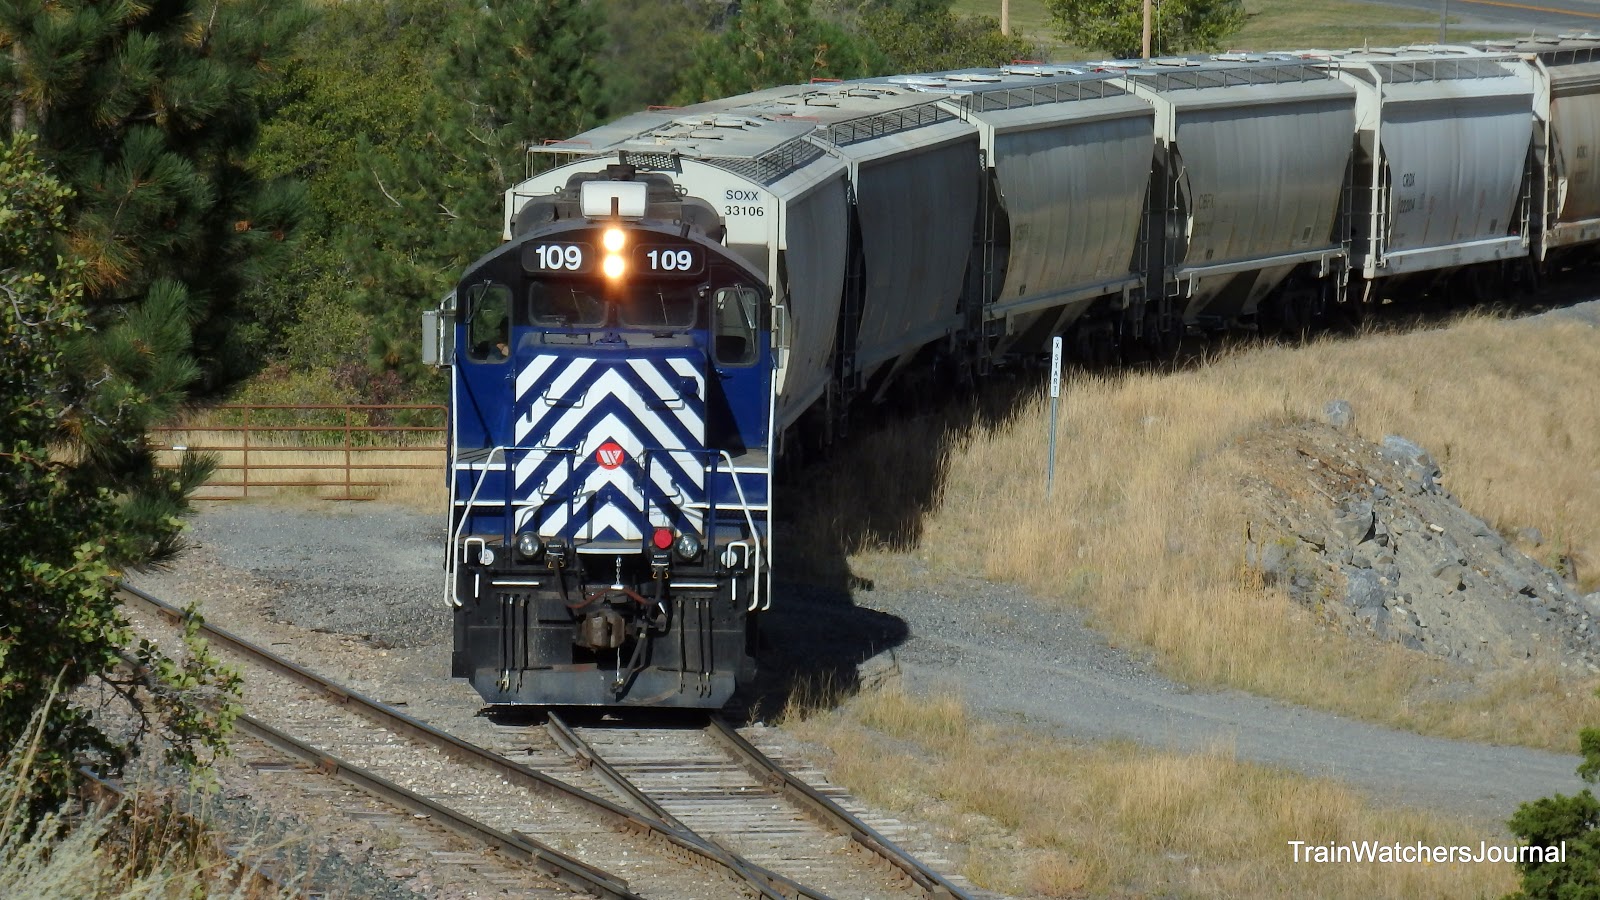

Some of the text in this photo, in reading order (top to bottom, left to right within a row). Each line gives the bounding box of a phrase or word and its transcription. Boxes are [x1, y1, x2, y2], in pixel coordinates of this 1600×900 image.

[725, 190, 758, 201] SOXX
[724, 205, 764, 217] 33106
[535, 245, 582, 271] 109
[647, 250, 692, 271] 109
